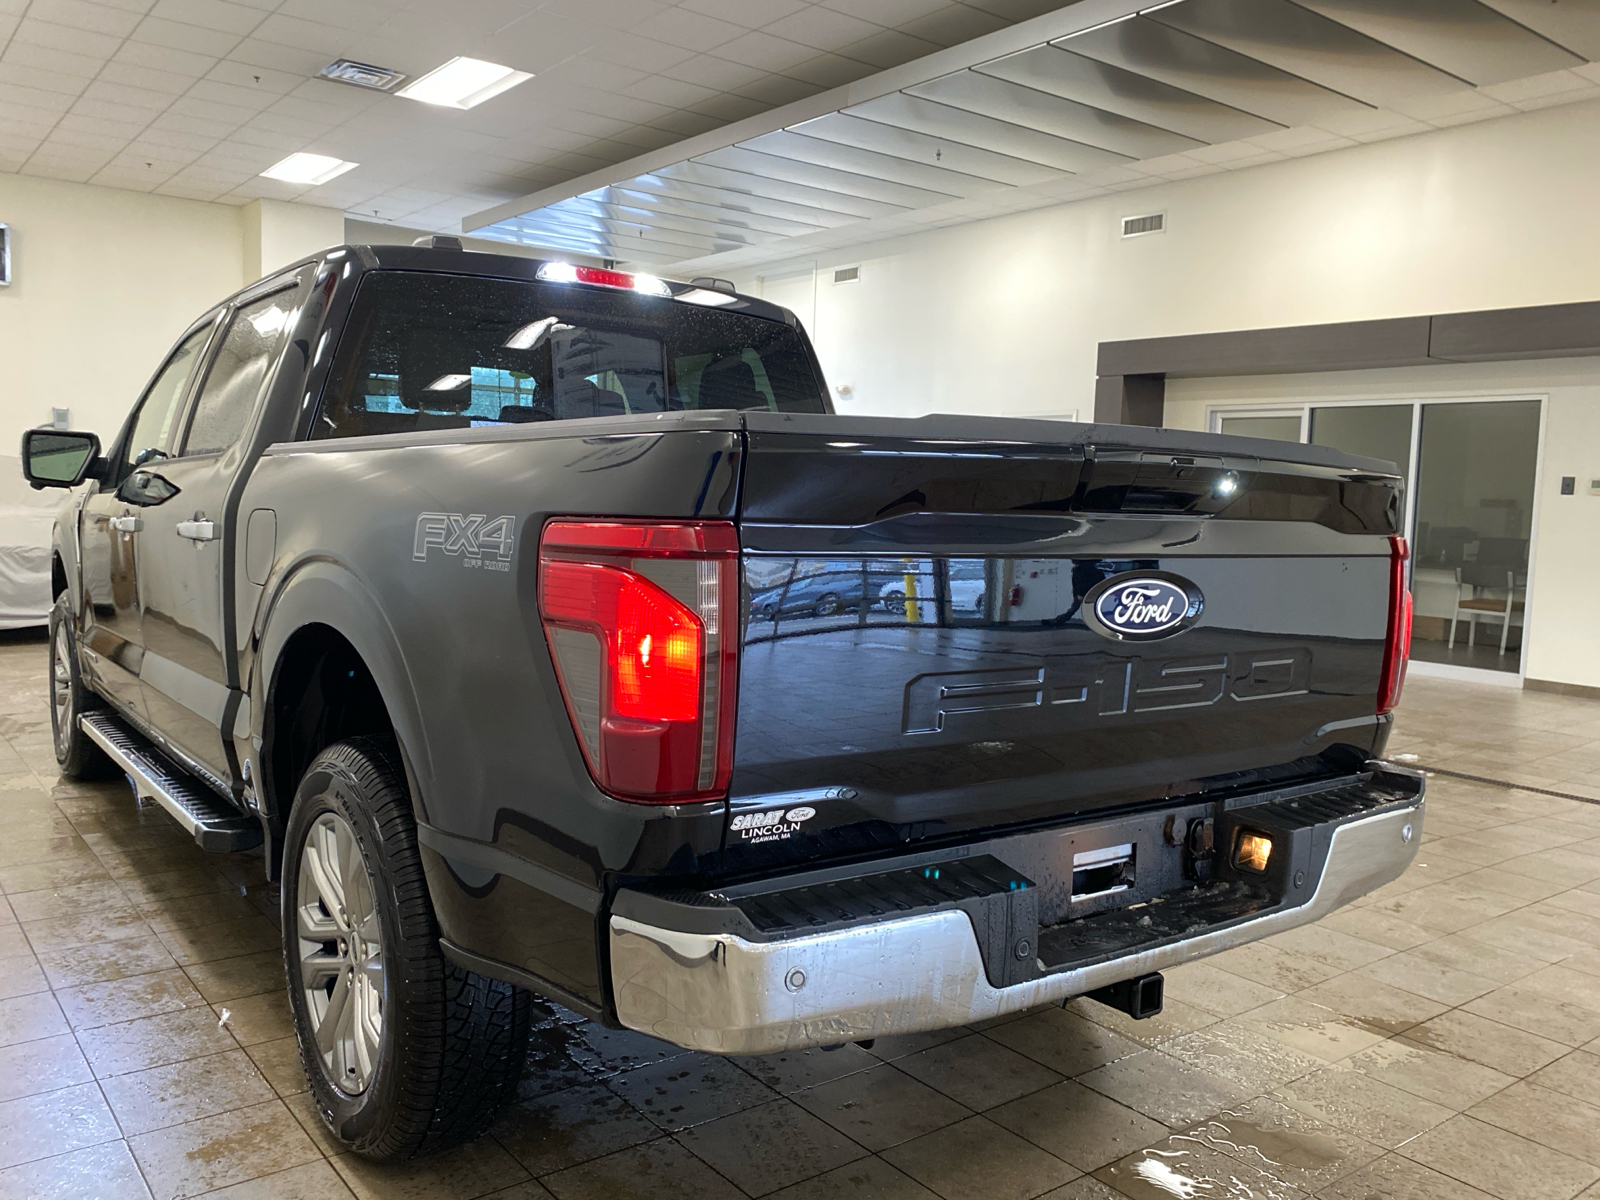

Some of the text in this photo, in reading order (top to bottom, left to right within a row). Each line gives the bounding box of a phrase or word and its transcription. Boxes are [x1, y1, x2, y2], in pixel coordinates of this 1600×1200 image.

[412, 512, 516, 562] FX4
[1114, 587, 1174, 624] Ford
[902, 646, 1312, 736] F-150
[730, 810, 785, 831] SARAT
[741, 822, 801, 839] LINCOLN
[780, 832, 791, 840] MA
